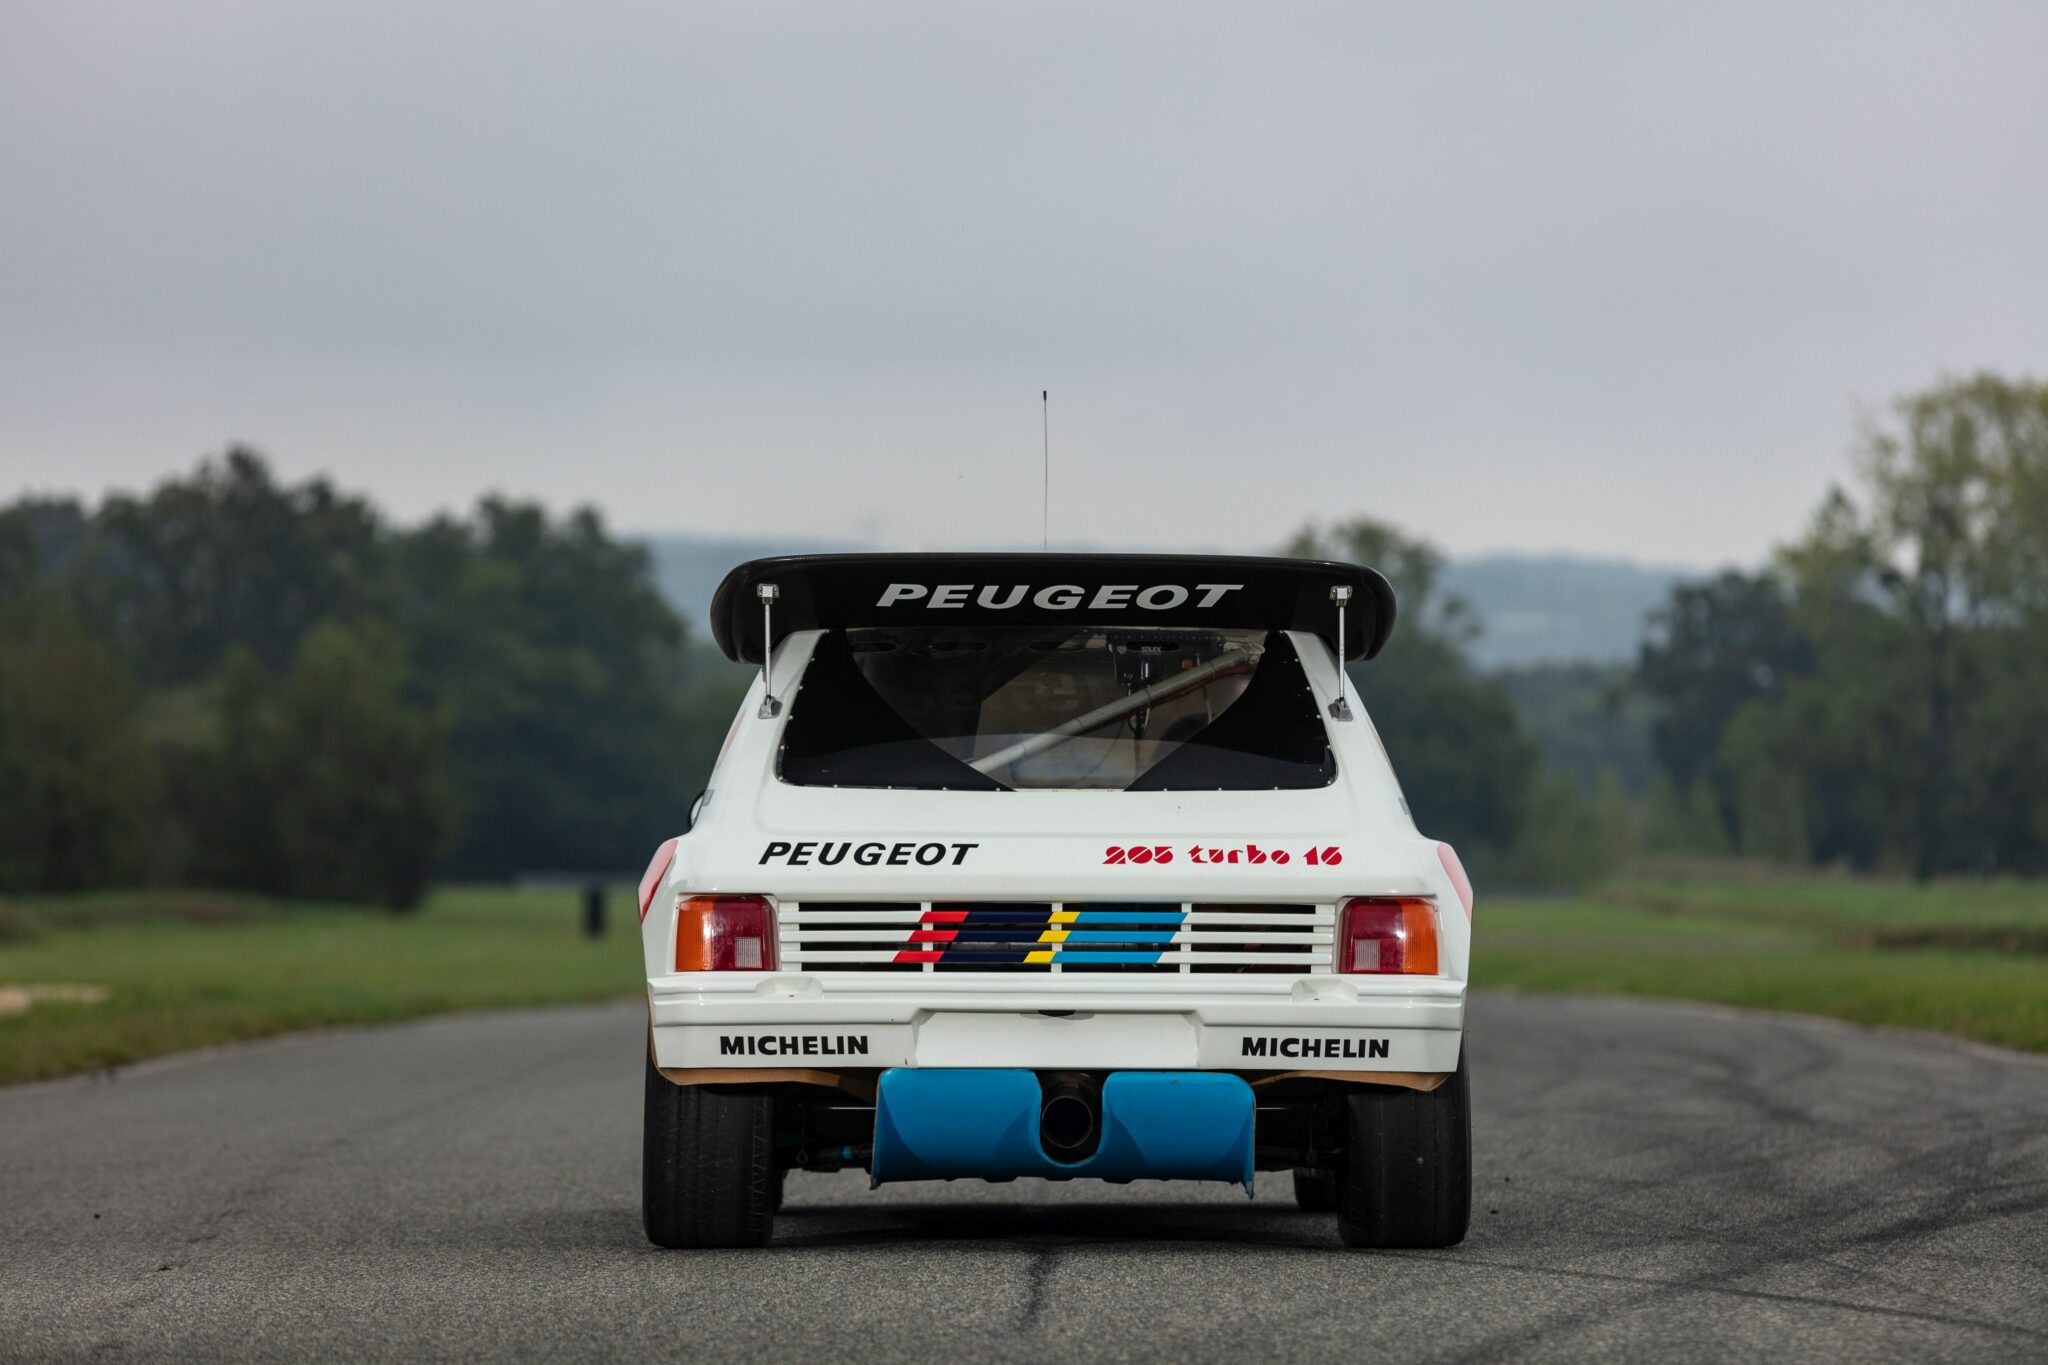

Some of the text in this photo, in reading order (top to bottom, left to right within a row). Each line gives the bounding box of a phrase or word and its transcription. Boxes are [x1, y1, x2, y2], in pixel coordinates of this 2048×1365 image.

[876, 583, 1244, 610] PEUGEOT
[759, 842, 979, 866] PEUGEOT
[1102, 844, 1343, 866] 205 turbo 16
[720, 1035, 868, 1056] MICHELIN
[1242, 1036, 1389, 1059] MICHELIN
